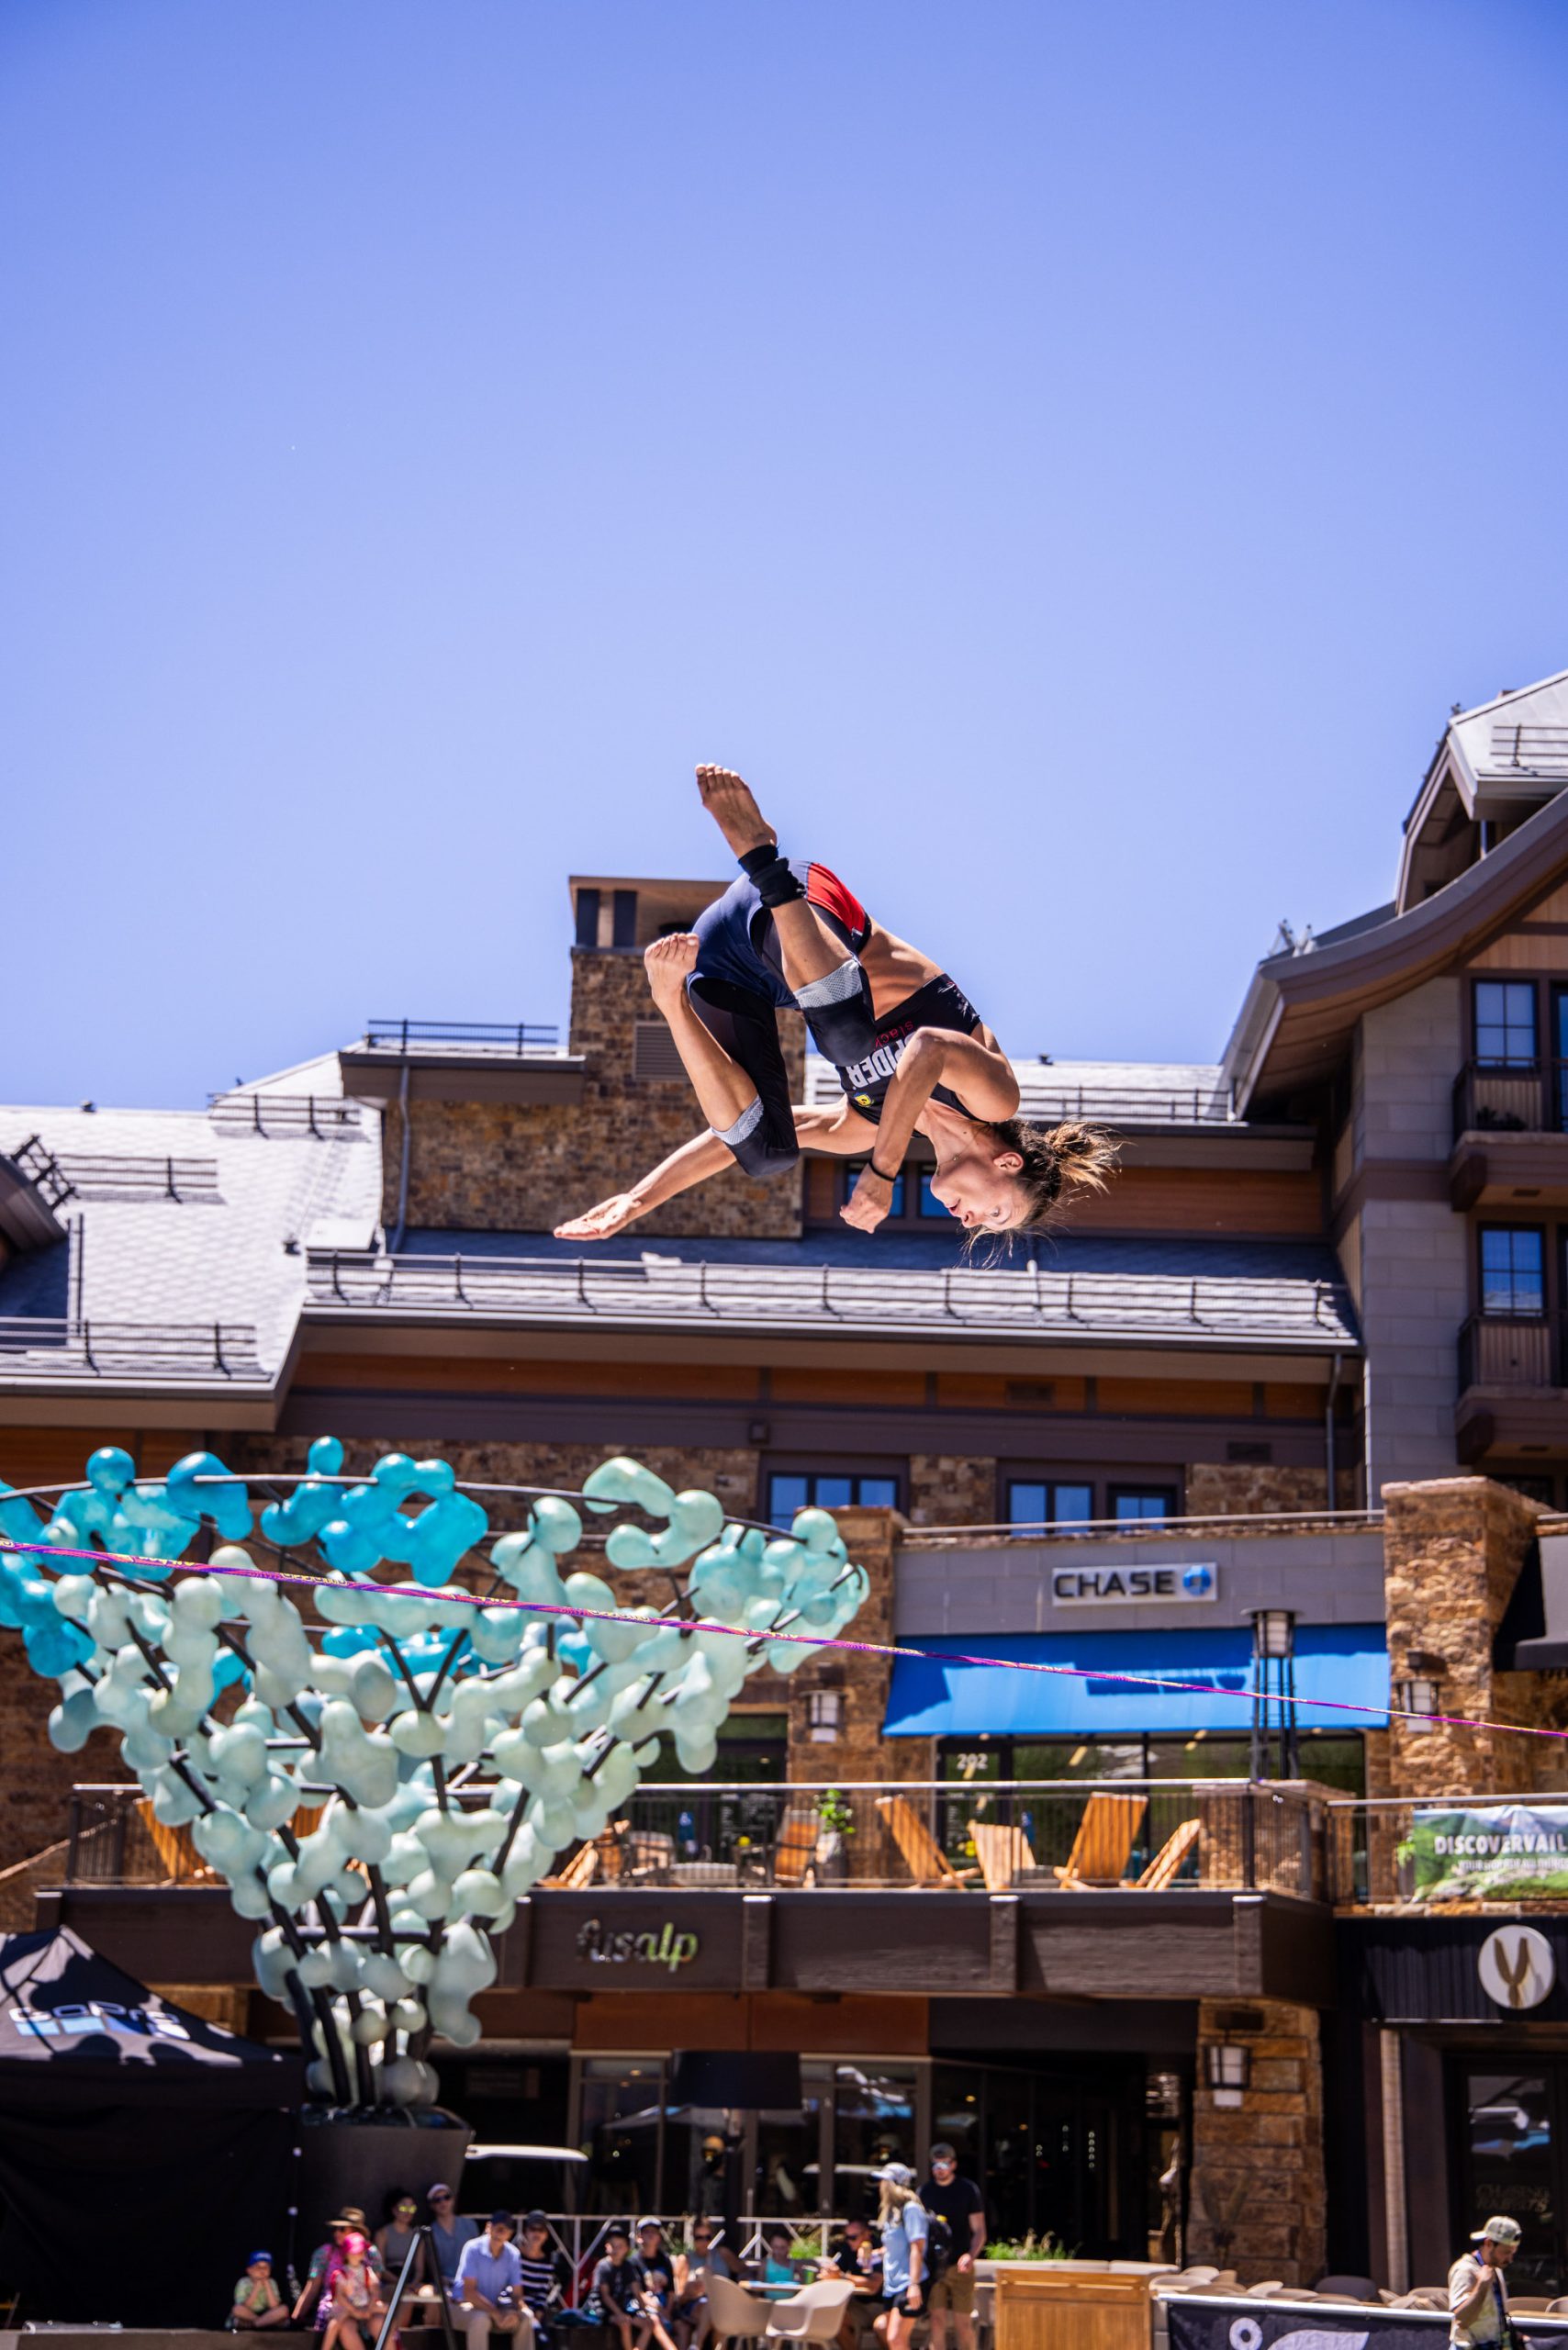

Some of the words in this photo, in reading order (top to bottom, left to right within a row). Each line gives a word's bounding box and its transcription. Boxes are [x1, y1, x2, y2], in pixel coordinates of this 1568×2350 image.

[1054, 1571, 1174, 1598] CHASE
[957, 1753, 988, 1770] 202
[576, 1919, 699, 1972] fusalp
